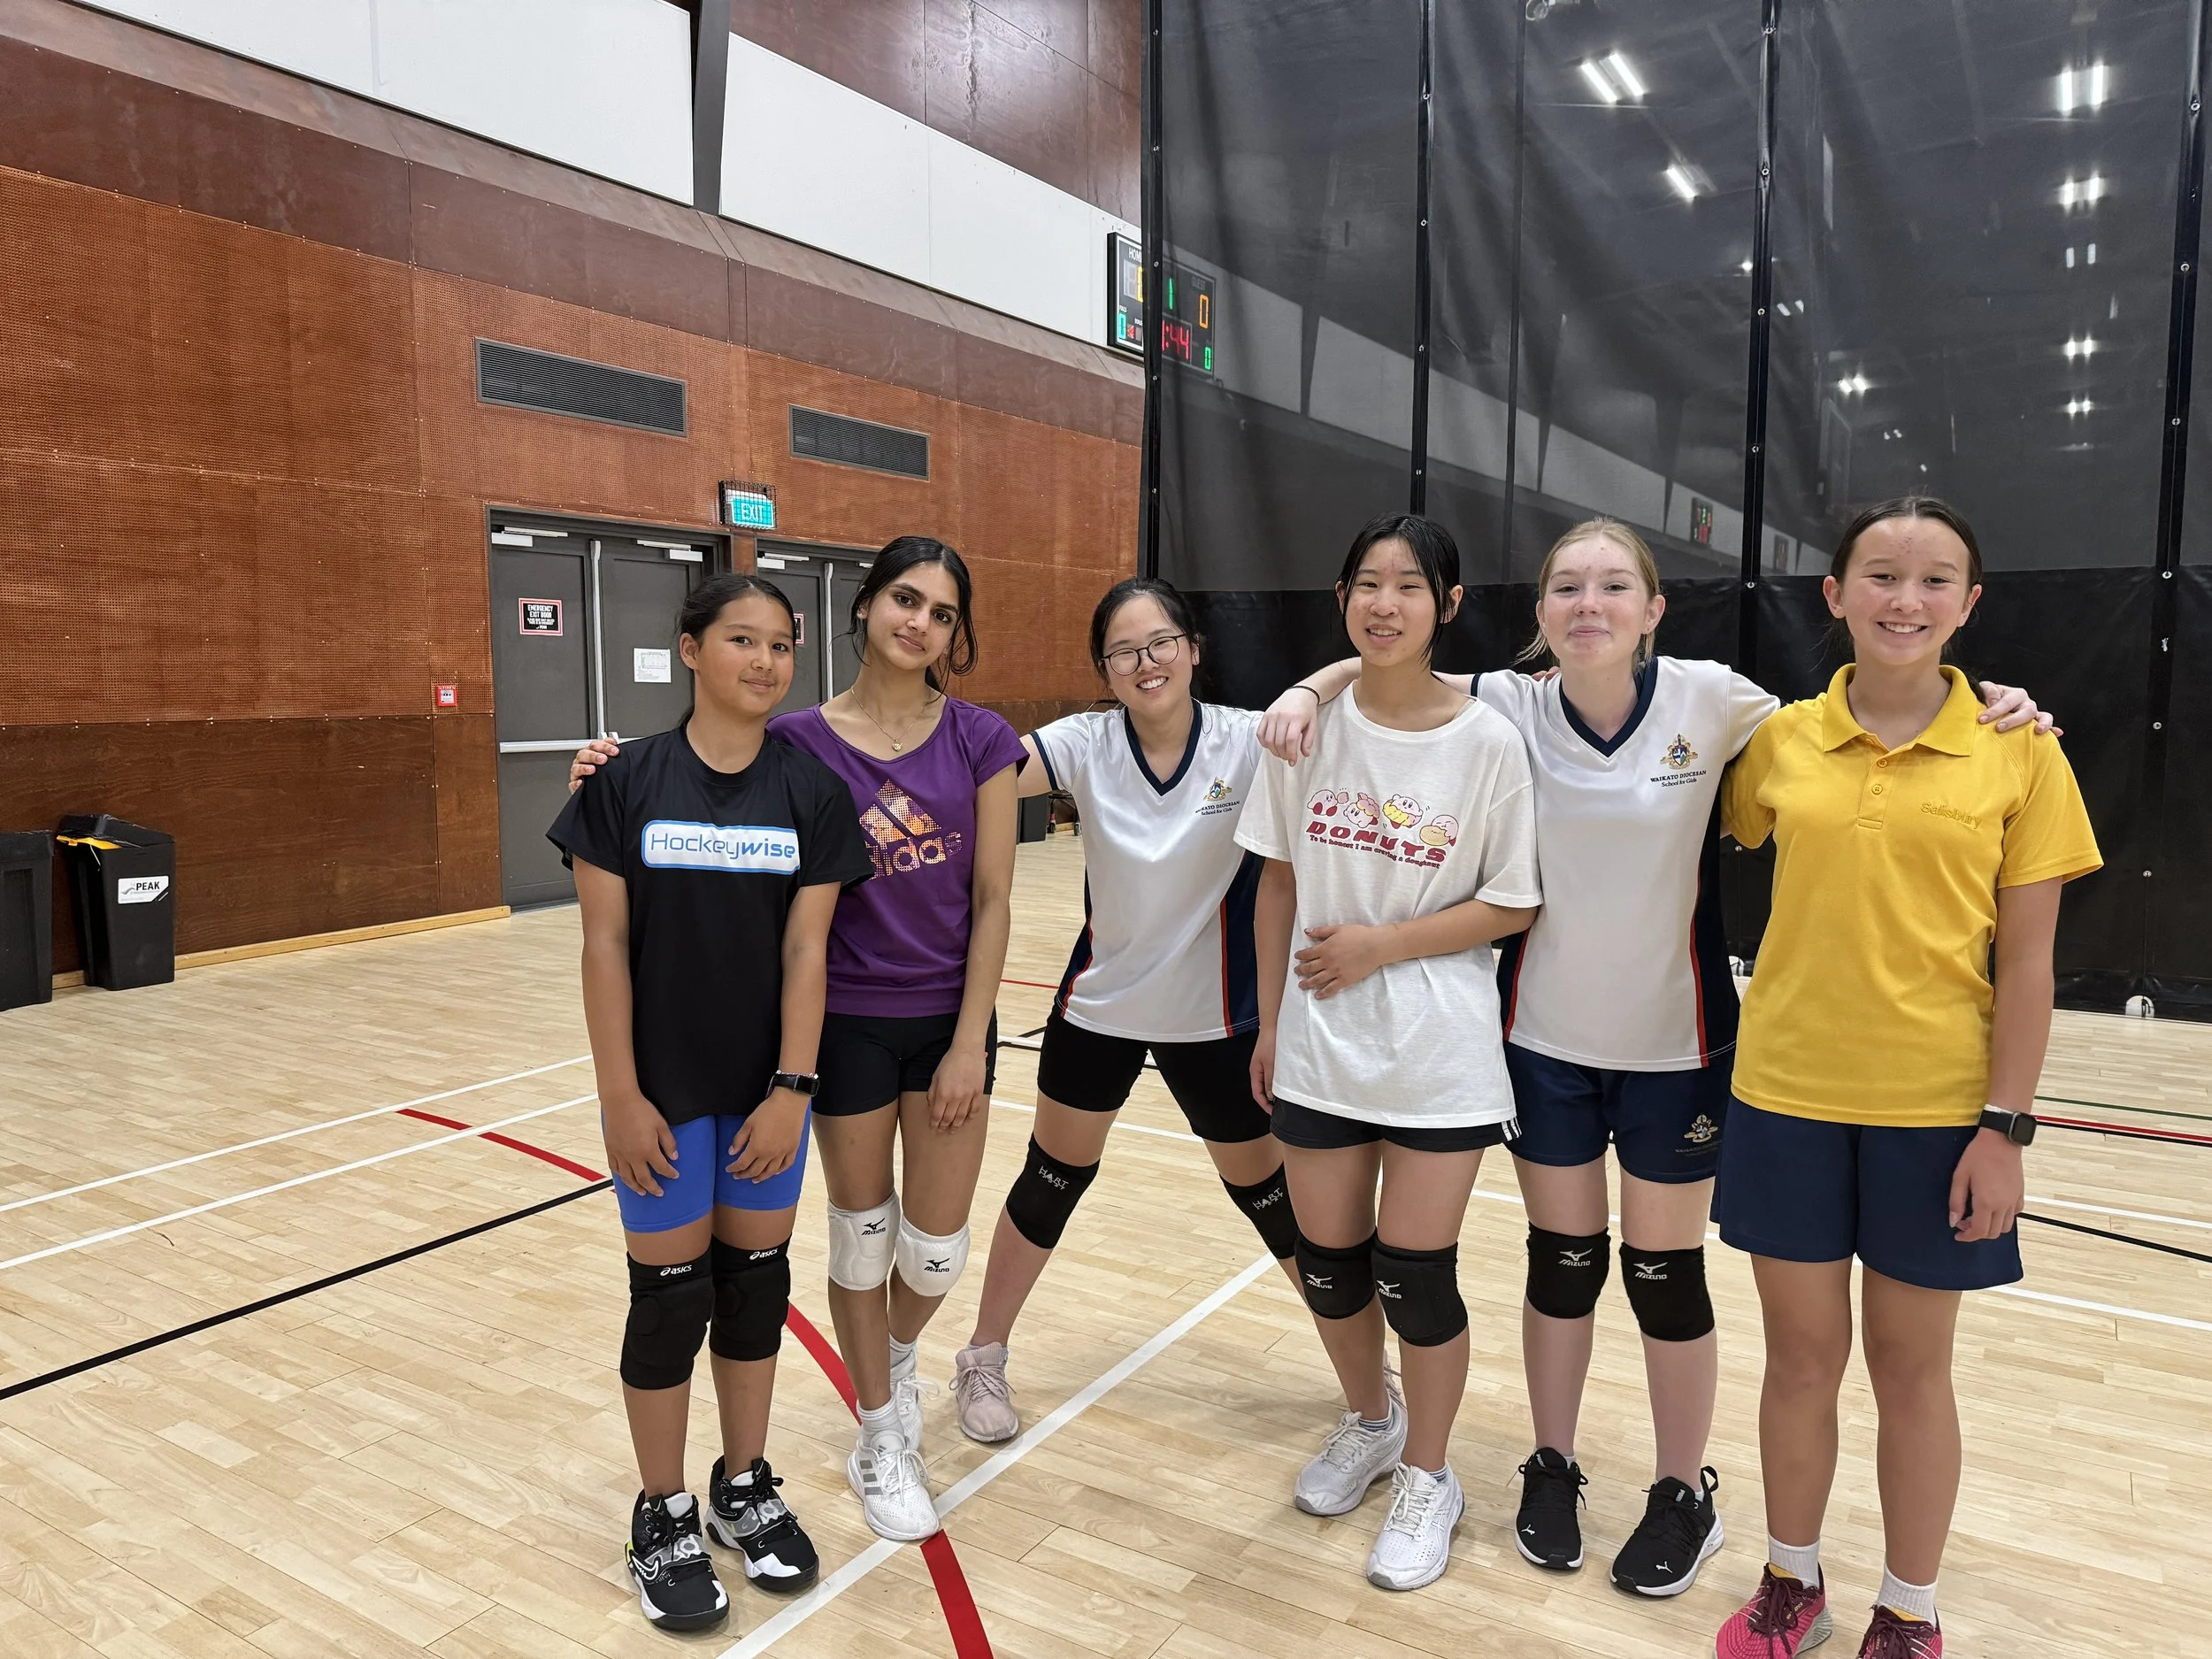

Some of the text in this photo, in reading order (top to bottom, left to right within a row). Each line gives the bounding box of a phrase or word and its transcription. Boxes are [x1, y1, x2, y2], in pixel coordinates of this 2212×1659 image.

[1129, 248, 1142, 263] HOM
[1200, 294, 1210, 329] 0
[741, 503, 764, 522] EXIT
[1650, 770, 1707, 783] WAIKATO DIOCESAN
[1921, 803, 1982, 830] Salisbury
[650, 832, 796, 860] Hockeywise
[1306, 821, 1448, 863] DONUTS
[1328, 839, 1354, 849] honest
[1374, 848, 1398, 862] craving
[135, 881, 160, 891] PEAK
[1038, 1165, 1069, 1190] HART
[1252, 1187, 1283, 1210] HART
